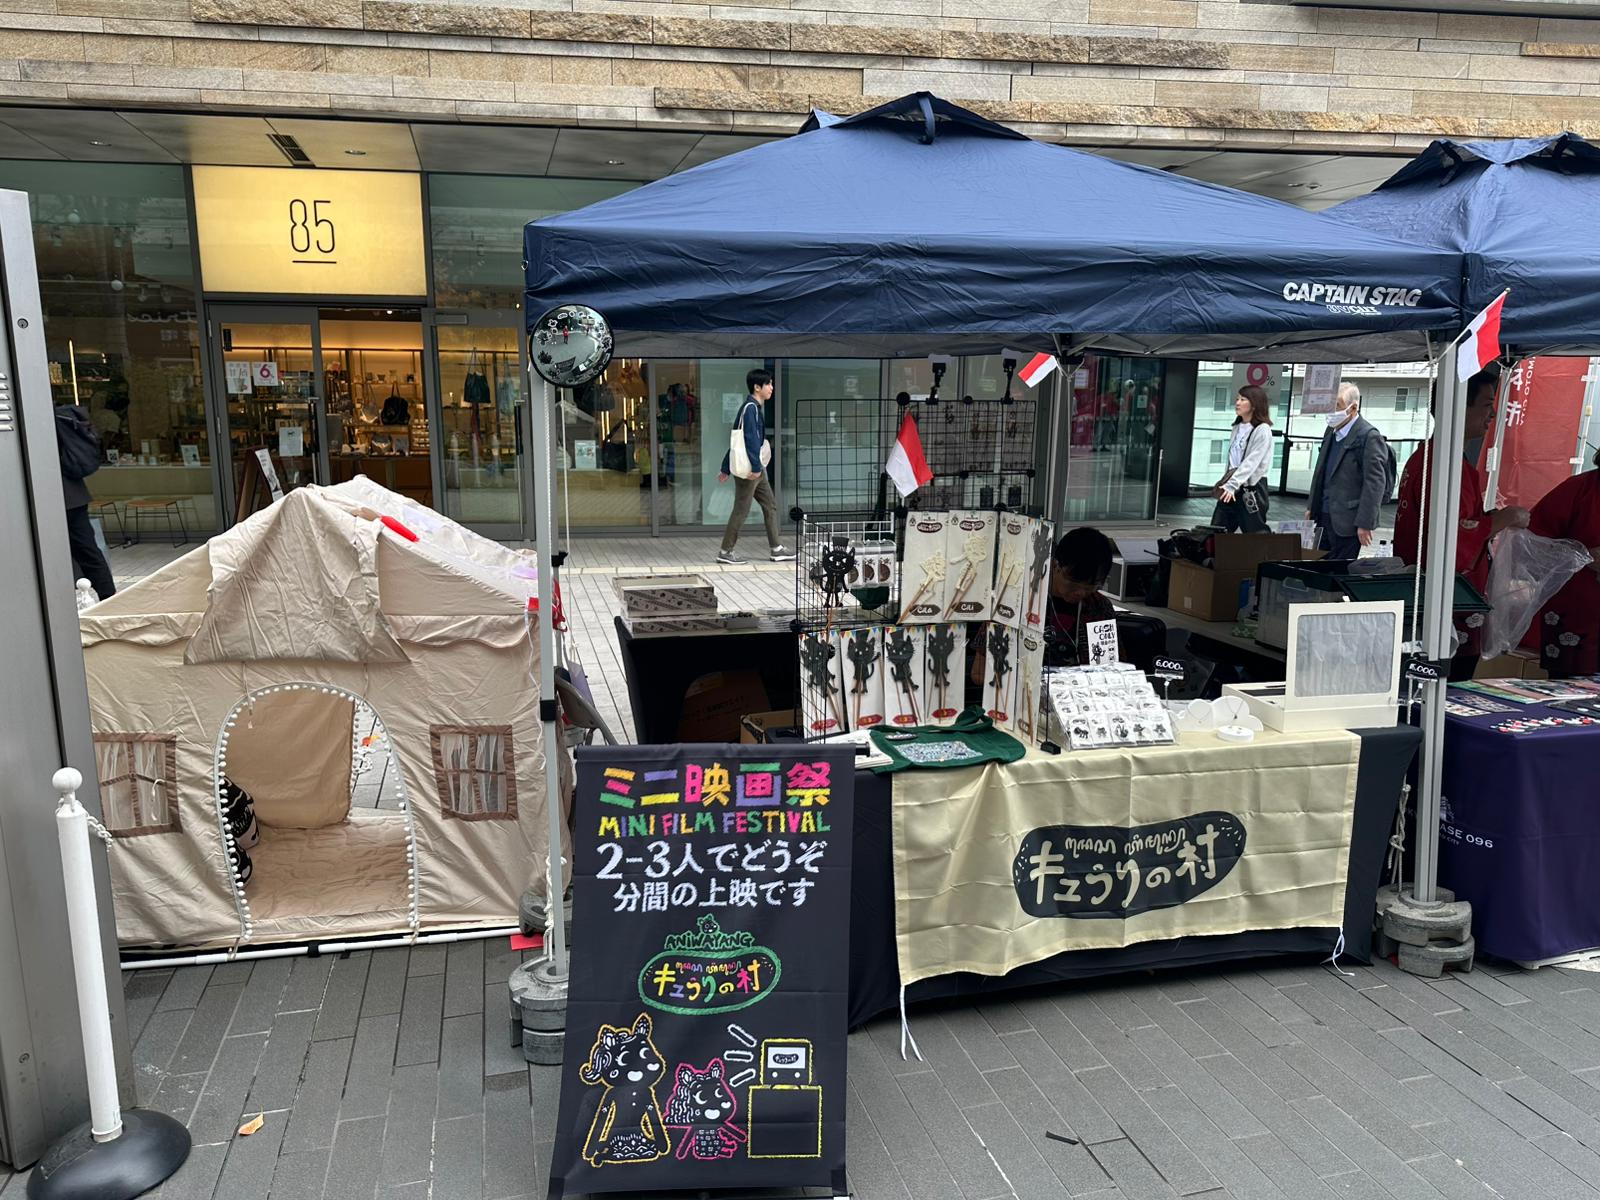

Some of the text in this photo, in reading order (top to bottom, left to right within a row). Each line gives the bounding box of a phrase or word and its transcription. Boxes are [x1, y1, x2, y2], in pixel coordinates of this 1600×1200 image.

[288, 199, 335, 253] 85
[1283, 282, 1422, 307] CAPTAIN STAG
[1093, 623, 1115, 635] CASH
[599, 762, 832, 808] ミニ映画祭
[598, 810, 832, 839] MINI FILM FESTIVAL
[1465, 834, 1494, 848] 096
[596, 839, 828, 880] 2-3人でどうぞ
[613, 877, 815, 913] 分間の上映です
